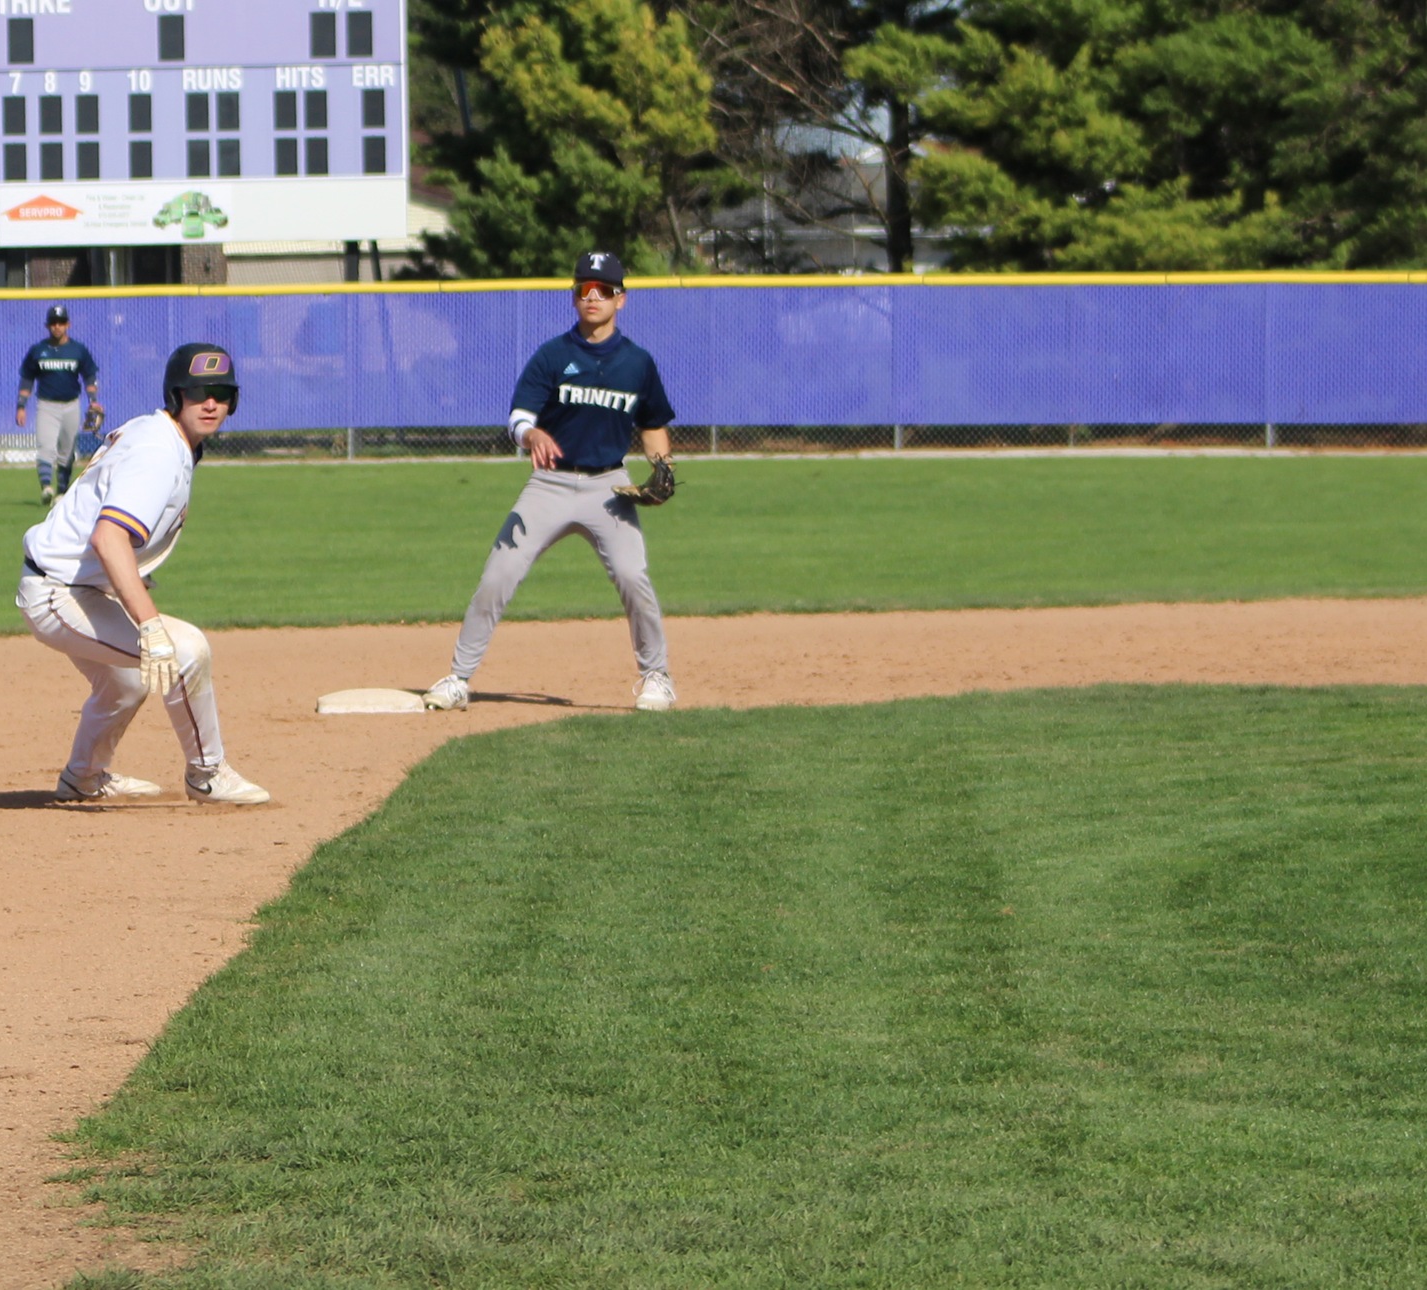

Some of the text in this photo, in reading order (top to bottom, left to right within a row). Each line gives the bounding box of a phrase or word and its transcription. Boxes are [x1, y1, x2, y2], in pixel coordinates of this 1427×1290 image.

[9, 72, 21, 94] 7
[44, 71, 56, 93] 8
[79, 71, 91, 92] 9
[127, 69, 151, 91] 10
[183, 68, 243, 89] RUNS
[275, 66, 326, 88] HITS
[352, 65, 394, 87] ERR
[19, 207, 63, 218] SERVPRO
[589, 253, 606, 271] T
[38, 360, 78, 372] TRINITY
[189, 352, 231, 377] O
[558, 383, 638, 413] TRINITY
